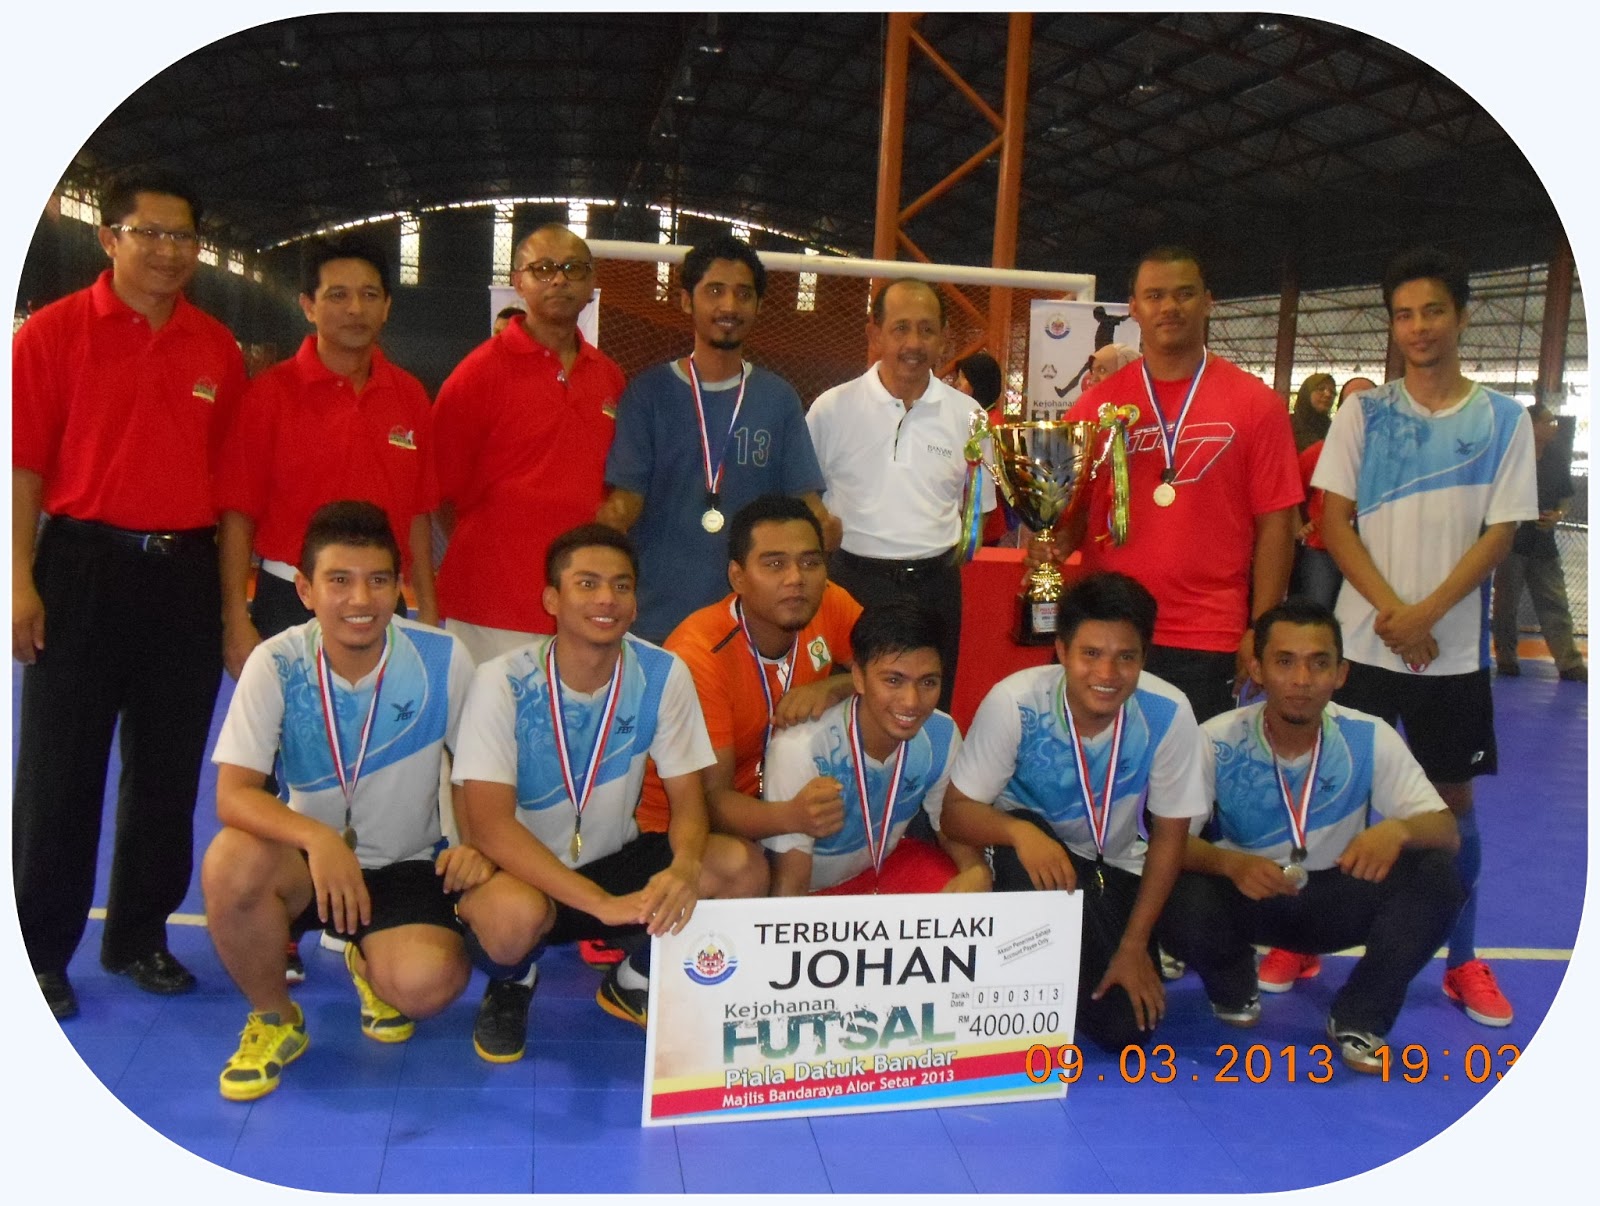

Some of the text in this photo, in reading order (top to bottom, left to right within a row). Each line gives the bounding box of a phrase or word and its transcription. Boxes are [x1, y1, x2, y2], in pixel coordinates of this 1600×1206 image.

[734, 427, 771, 467] 13
[754, 917, 994, 945] TERBUKA LELAKI
[768, 945, 977, 990] JOHAN
[725, 998, 835, 1019] Kejohanan
[950, 1000, 965, 1008] Date
[958, 1011, 1060, 1036] RM 4000.00
[723, 1002, 956, 1064] FUTSAL
[725, 1048, 957, 1089] Piala Datuk Bandar
[722, 1069, 954, 1108] Majlis Bandaraya Alor Setar 2013
